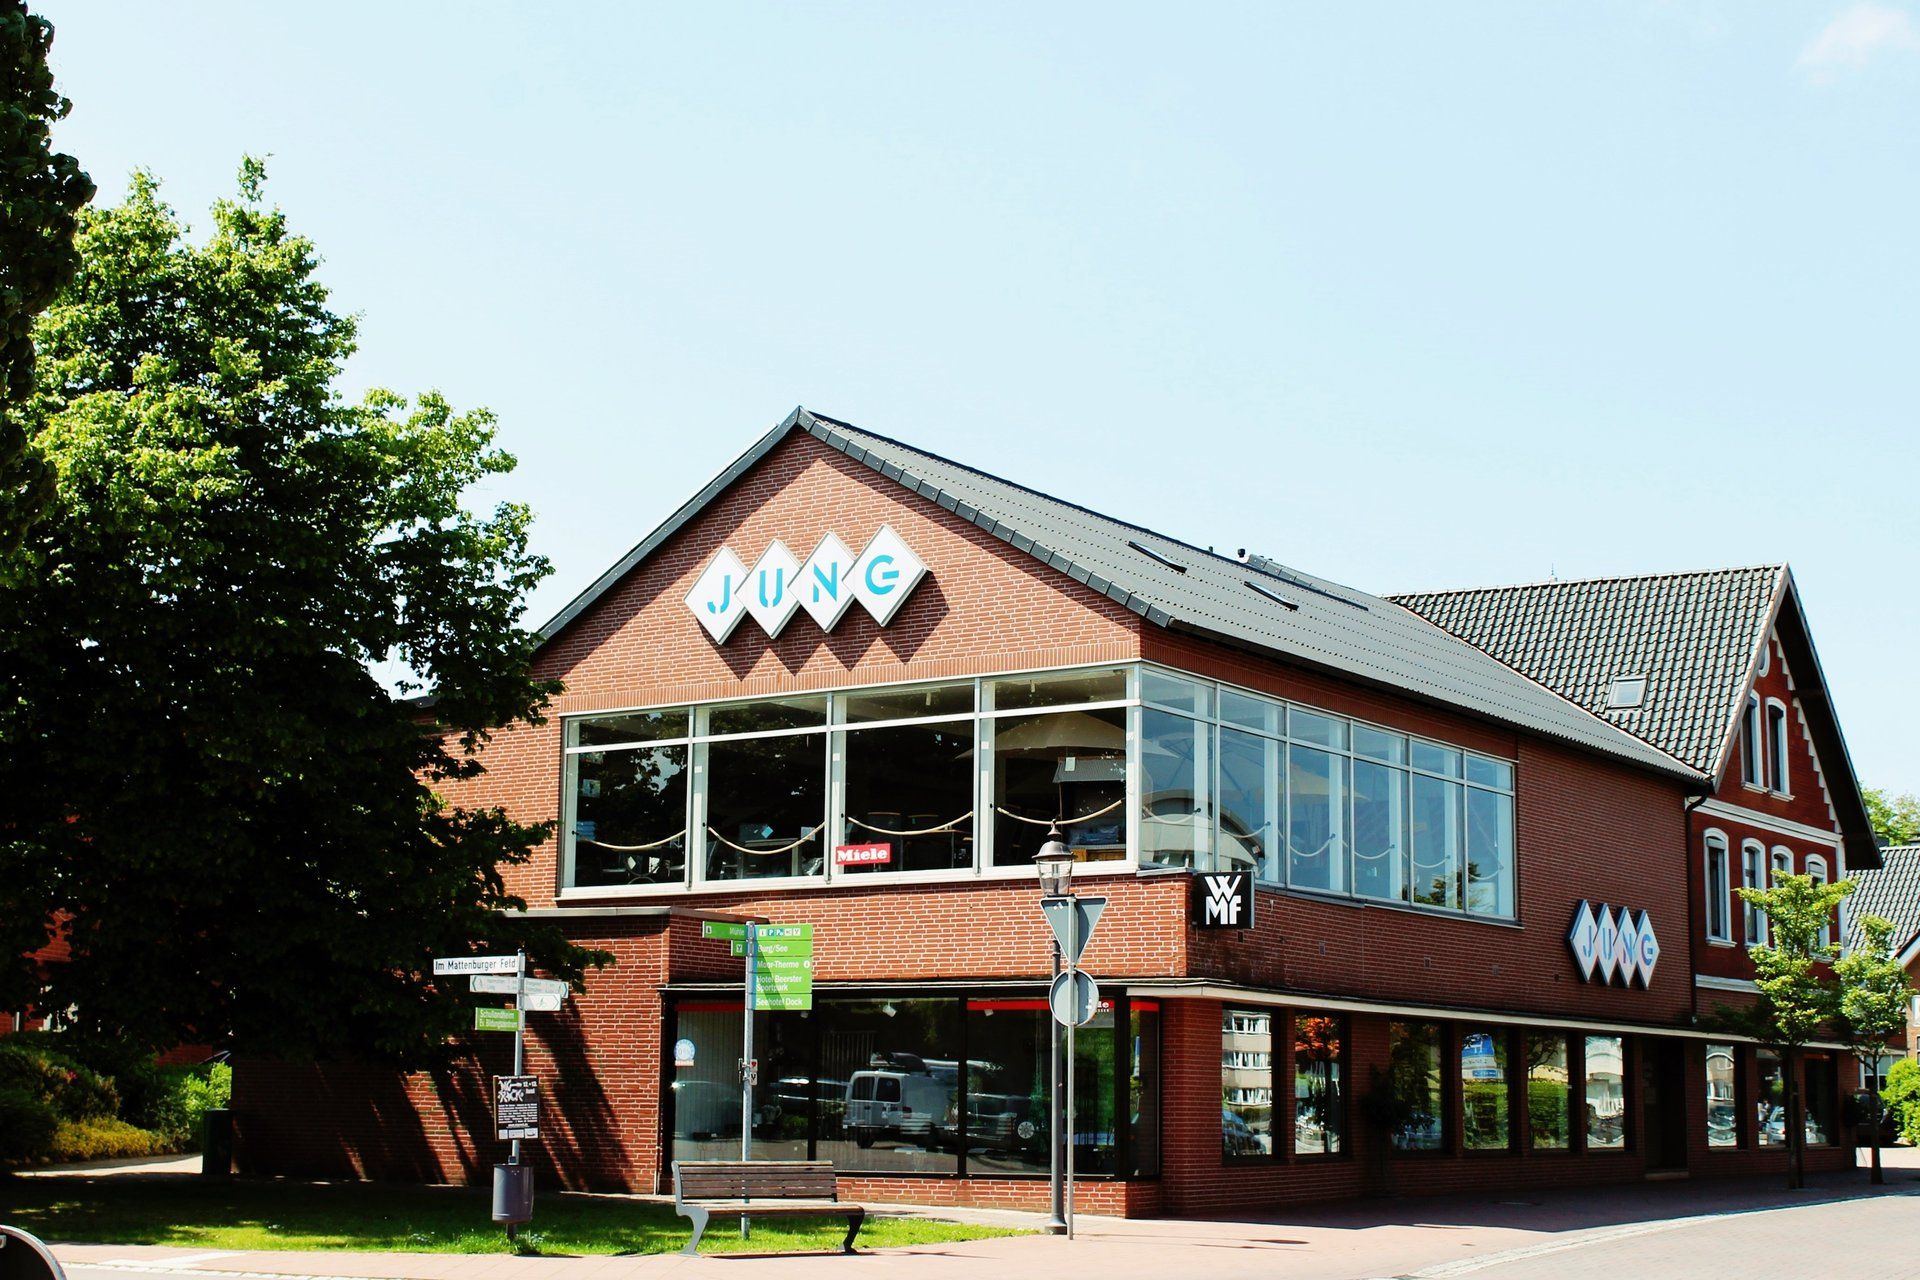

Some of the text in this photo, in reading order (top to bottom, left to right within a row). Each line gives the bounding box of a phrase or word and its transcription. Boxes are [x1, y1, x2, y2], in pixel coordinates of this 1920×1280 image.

[707, 555, 899, 614] JUNG
[837, 848, 888, 862] Miele
[758, 944, 788, 954] Burg/See
[1583, 925, 1654, 966] JUNG
[435, 959, 516, 972] Im Mattenburger Feld
[757, 960, 800, 969] Moor-Therme
